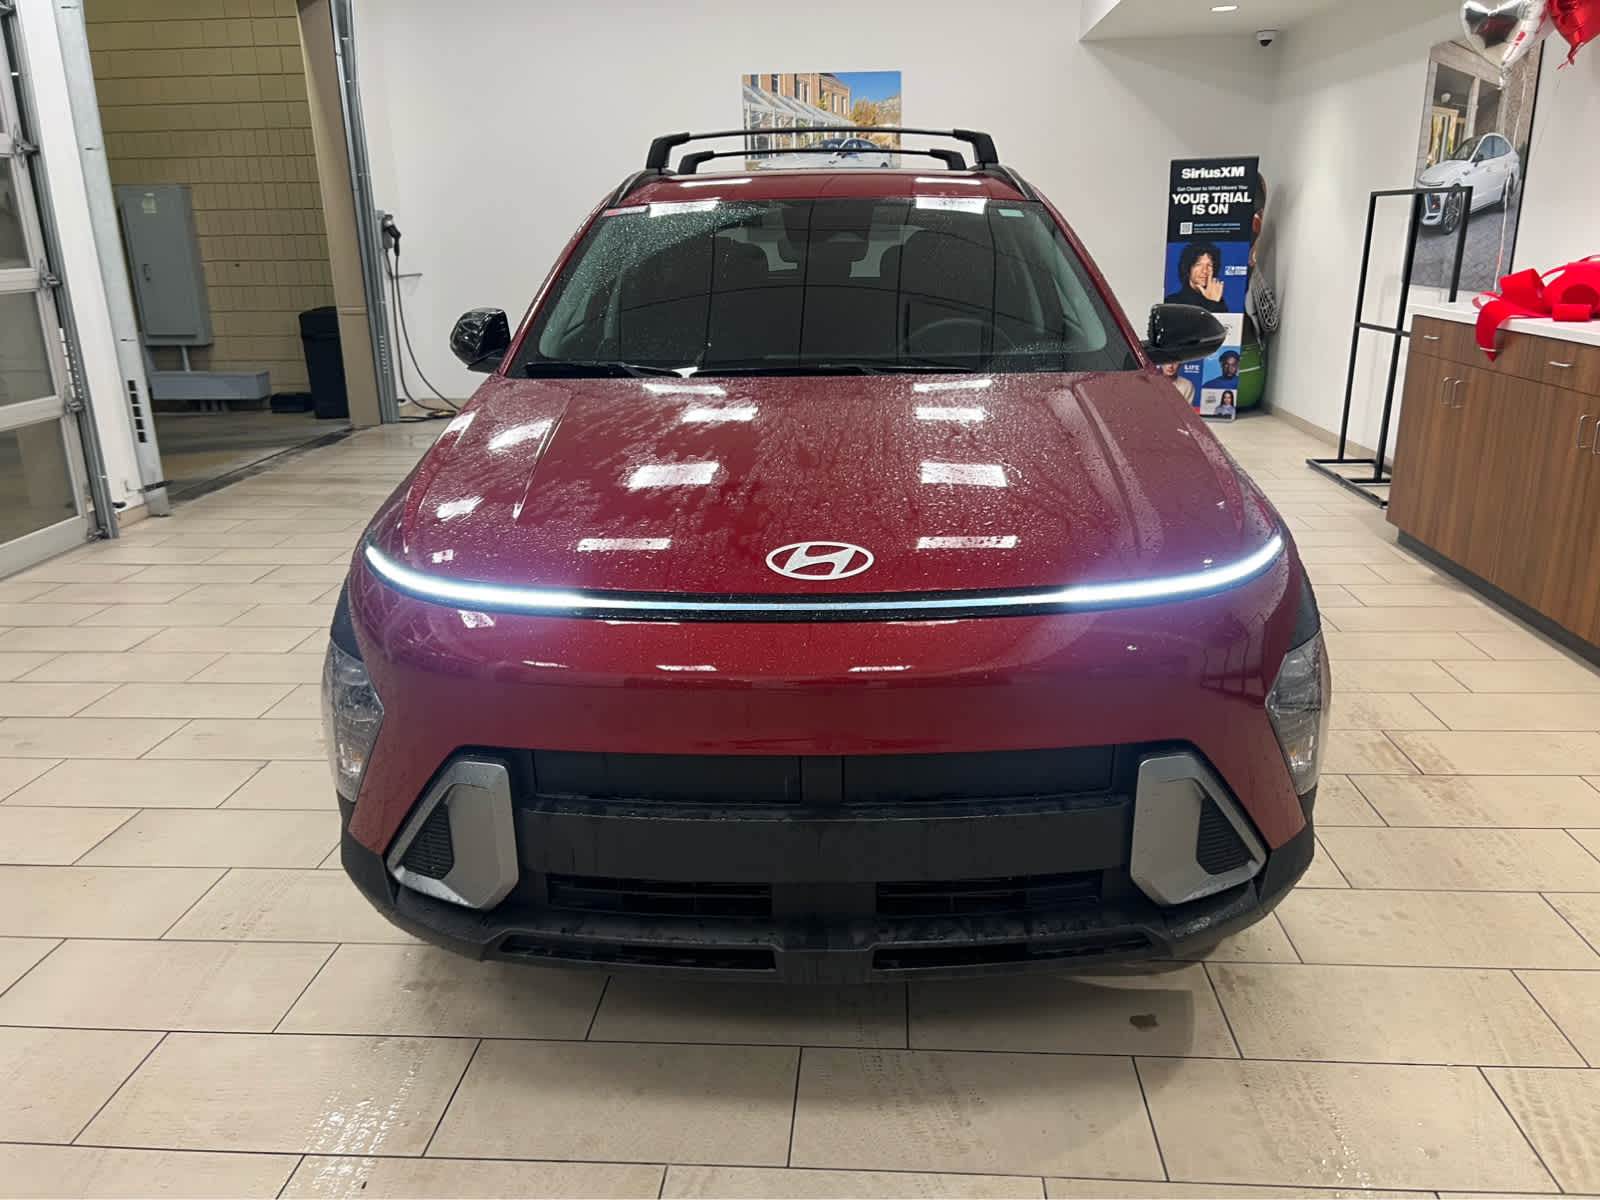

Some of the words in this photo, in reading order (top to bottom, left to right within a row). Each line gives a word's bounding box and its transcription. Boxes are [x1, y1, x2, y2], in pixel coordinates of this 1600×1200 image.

[1181, 166, 1245, 179] SiriusXM
[1172, 193, 1210, 204] YOUR
[1211, 192, 1252, 203] TRIAL
[1192, 204, 1206, 215] IS
[1208, 204, 1229, 214] ON
